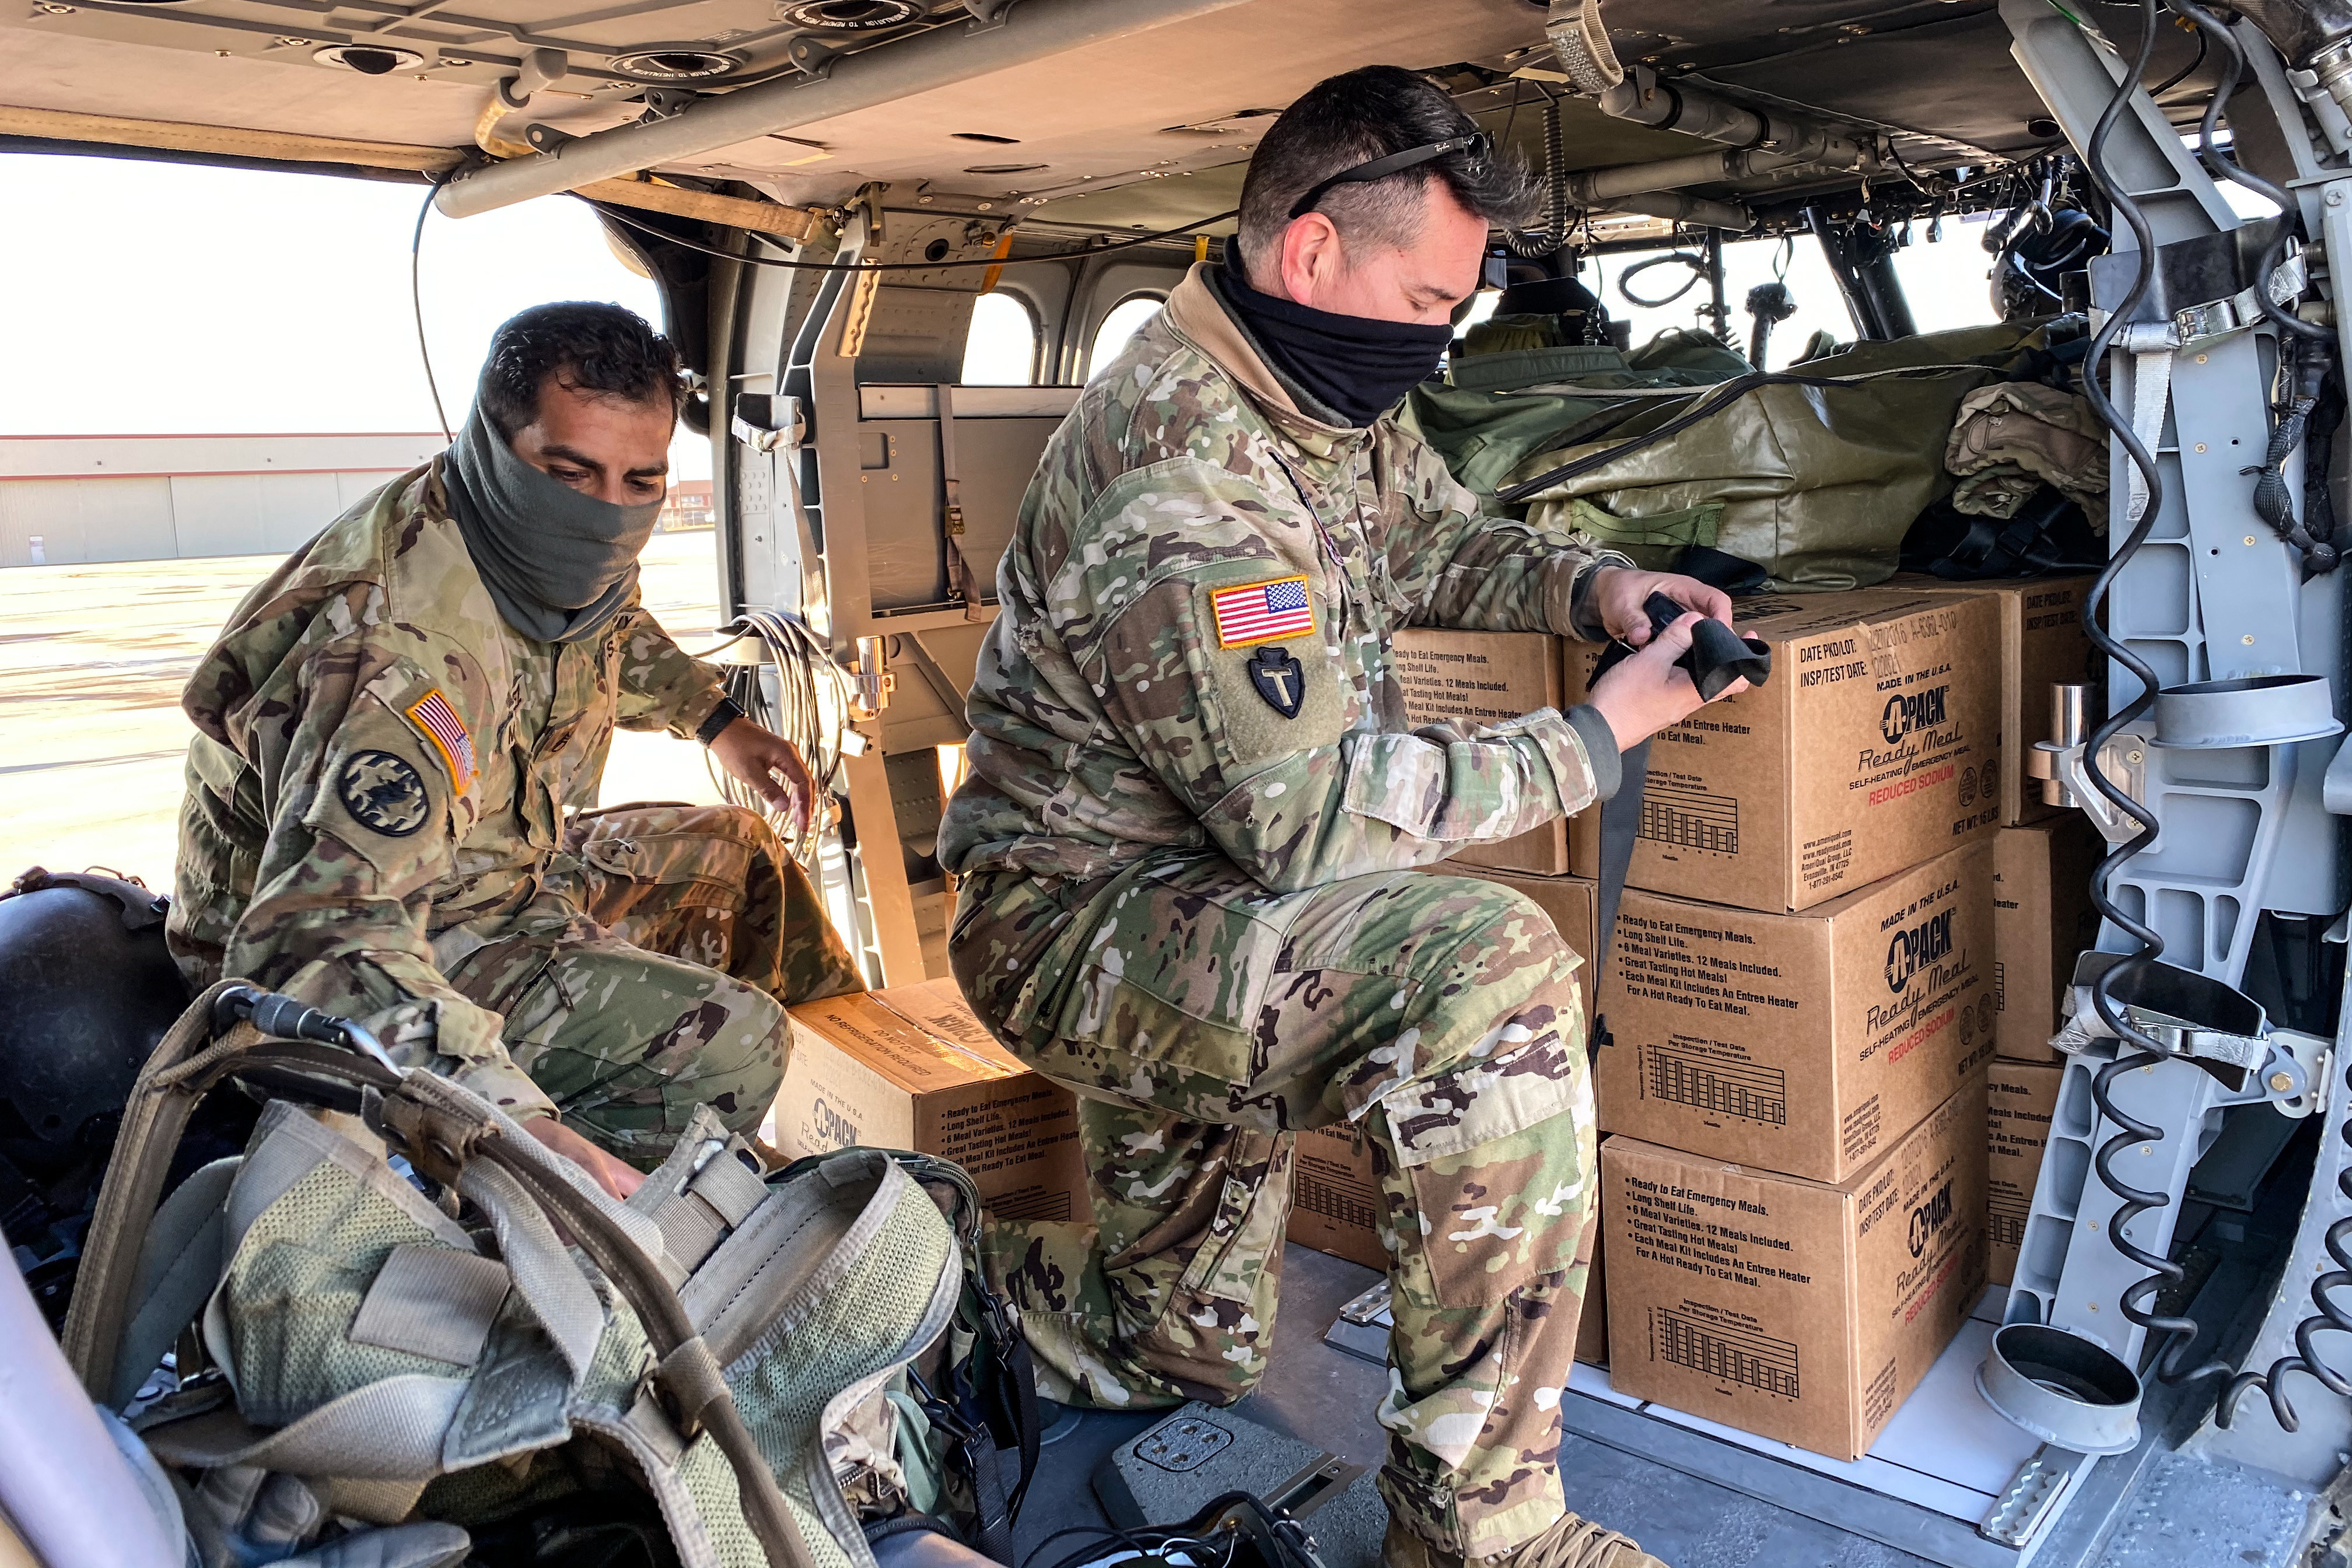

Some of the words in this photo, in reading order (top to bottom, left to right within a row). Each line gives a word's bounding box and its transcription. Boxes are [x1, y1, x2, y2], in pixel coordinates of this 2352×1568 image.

[1393, 649, 1409, 660] eady
[1419, 650, 1428, 660] Eat
[1430, 652, 1464, 664] Emergency
[1466, 654, 1489, 664] Meals.
[1801, 646, 1822, 663] DATE
[1824, 639, 1856, 659] PKD/LOT:
[1408, 663, 1423, 672] Shelf
[1425, 665, 1438, 673] Life.
[1801, 665, 1844, 688] INSP/TEST
[1847, 661, 1868, 678] DATE:
[1877, 678, 1902, 692] MADE
[1905, 674, 1913, 684] IN
[1916, 669, 1929, 681] THE
[1932, 663, 1951, 676] U.S.A.
[1261, 668, 1293, 706] T
[1410, 690, 1432, 700] Tasting
[1434, 691, 1444, 700] Hot
[1447, 692, 1468, 702] Meals!
[1415, 677, 1443, 687] Varieties.
[1446, 679, 1453, 688] 12
[1455, 680, 1475, 690] Meals
[1477, 681, 1508, 692] Included.
[1409, 702, 1423, 711] Meal
[1426, 703, 1434, 712] Kit
[1436, 704, 1463, 715] Includes
[1465, 706, 1473, 715] An
[1475, 708, 1496, 718] Entree
[1499, 709, 1521, 718] Heater
[1668, 731, 1680, 742] Eat
[1684, 733, 1706, 745] Meal.
[1681, 719, 1690, 728] An
[1694, 720, 1720, 732] Entree
[1723, 722, 1750, 734] Heater
[1859, 740, 1920, 776] Ready
[1923, 722, 1963, 752] Meal
[1850, 768, 1902, 790] SELF-HEATING
[1912, 751, 1953, 771] EMERGENCY
[1954, 745, 1971, 756] MEAL
[1869, 779, 1916, 806] REDUCED
[1919, 764, 1954, 789] SODIUM
[1843, 848, 1852, 857] LLC
[1881, 912, 1905, 932] MADE
[1908, 904, 1917, 916] IN
[1920, 893, 1934, 909] THE
[1937, 880, 1959, 900] U.S.A.
[1623, 915, 1647, 929] Ready
[1650, 919, 1657, 929] to
[1660, 921, 1672, 932] Eat
[1676, 923, 1722, 941] Emergency
[1725, 932, 1755, 944] Meals.
[1624, 929, 1643, 942] Long
[1646, 933, 1666, 944] Shelf
[1669, 937, 1688, 948] Life.
[1626, 957, 1647, 969] Great
[1650, 961, 1678, 976] Tasting
[1681, 967, 1695, 977] Hot
[1698, 969, 1727, 983] Meals!
[1632, 944, 1651, 956] Meal
[1654, 948, 1693, 963] Varieties.
[1696, 956, 1707, 965] 12
[1710, 957, 1737, 970] Meals
[1740, 963, 1781, 977] Included.
[1626, 971, 1644, 982] Each
[1647, 974, 1667, 987] Meal
[1670, 979, 1681, 989] Kit
[1684, 981, 1720, 996] Includes
[1723, 988, 1733, 998] An
[1737, 991, 1764, 1003] Entree
[1768, 995, 1798, 1009] Heater
[1628, 985, 1640, 995] For
[1643, 988, 1648, 997] A
[1651, 989, 1664, 1000] Hot
[1667, 992, 1692, 1007] Ready
[1695, 997, 1705, 1008] To
[1709, 999, 1722, 1011] Eat
[1725, 1002, 1749, 1016] Meal.
[1867, 985, 1925, 1037] Ready
[1929, 949, 1971, 995] Meal
[1860, 1019, 1910, 1061] SELF-HEATING
[1919, 987, 1959, 1020] EMERGENCY
[1889, 1029, 1924, 1065] REDUCED
[1926, 1006, 1955, 1037] SODIUM
[837, 1021, 891, 1055] REFRIGERATION
[887, 1052, 931, 1076] REQUIRED
[886, 1037, 905, 1046] NOT
[900, 1046, 921, 1055] CUT
[810, 1079, 825, 1094] MADE
[827, 1091, 833, 1099] IN
[835, 1096, 845, 1108] THE
[947, 1107, 969, 1118] Ready
[971, 1105, 978, 1113] to
[980, 1102, 991, 1111] Eat
[993, 1093, 1030, 1108] Emergency
[1632, 1177, 1657, 1193] Ready
[1660, 1183, 1668, 1194] to
[1671, 1185, 1685, 1197] Eat
[1687, 1189, 1735, 1210] Emergency
[1739, 1199, 1769, 1216] Meals.
[1633, 1191, 1651, 1206] Long
[1655, 1197, 1675, 1211] Shelf
[1679, 1203, 1698, 1216] Life.
[1633, 1205, 1638, 1214] 6
[1641, 1206, 1660, 1221] Meal
[1663, 1212, 1703, 1232] Varieties.
[1706, 1224, 1717, 1235] 12
[1720, 1227, 1747, 1242] Meals
[1750, 1233, 1793, 1251] Included.
[1634, 1219, 1656, 1232] Great
[1658, 1226, 1687, 1242] Tasting
[1691, 1234, 1704, 1245] Hot
[1708, 1238, 1737, 1254] Meals!
[1635, 1233, 1654, 1246] Each
[1657, 1238, 1676, 1252] Meal
[1679, 1244, 1690, 1256] Kit
[1694, 1248, 1730, 1266] Includes
[1732, 1258, 1744, 1269] An
[1747, 1261, 1776, 1276] Entree
[1779, 1269, 1810, 1284] Heater
